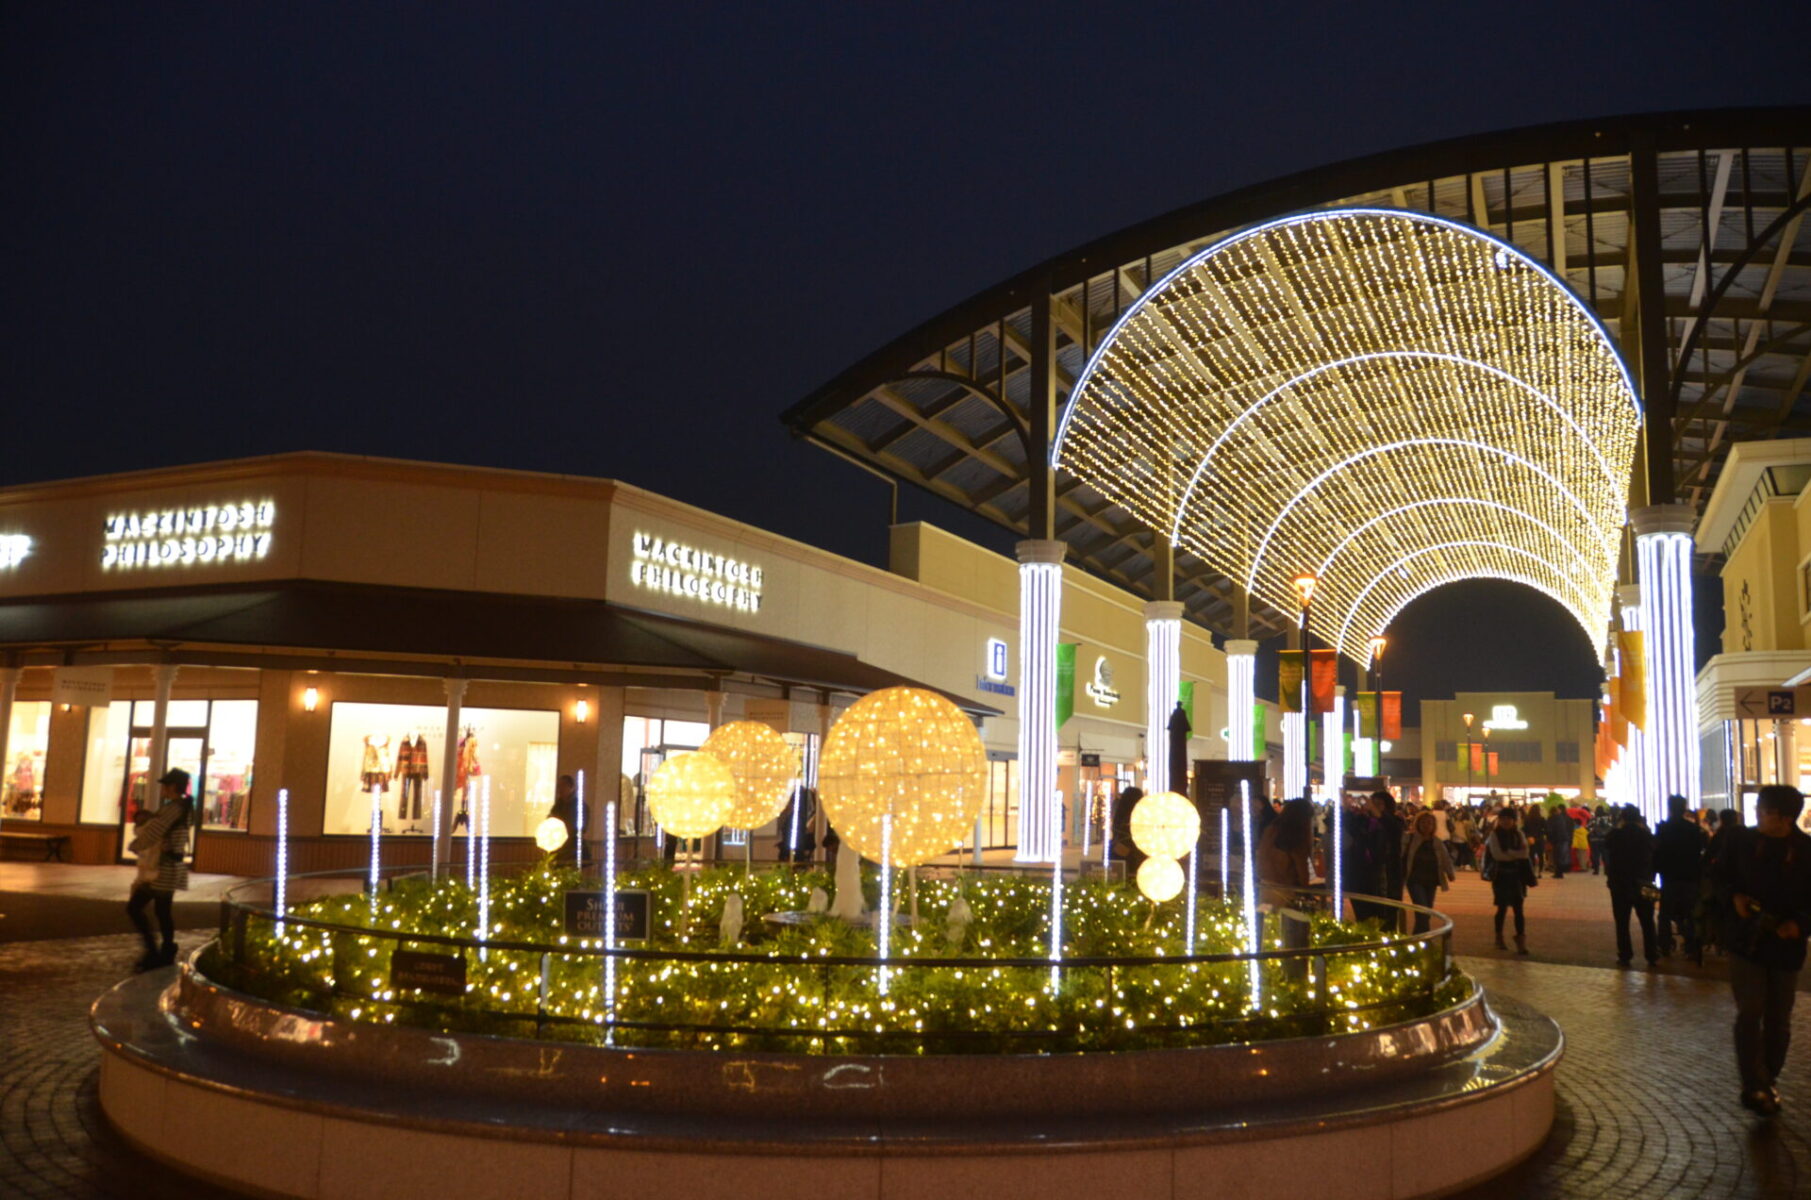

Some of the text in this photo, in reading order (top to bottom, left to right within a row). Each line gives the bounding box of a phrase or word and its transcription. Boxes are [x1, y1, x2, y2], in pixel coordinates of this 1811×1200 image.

[103, 502, 274, 538] MACKINTOSH
[101, 532, 270, 569] PHILOSOPHY
[634, 533, 764, 587] MACKINTOSH
[632, 561, 763, 612] PHILOSOPHY
[1770, 695, 1792, 710] P2
[576, 910, 635, 922] PREMUM
[576, 921, 634, 932] OUTTS
